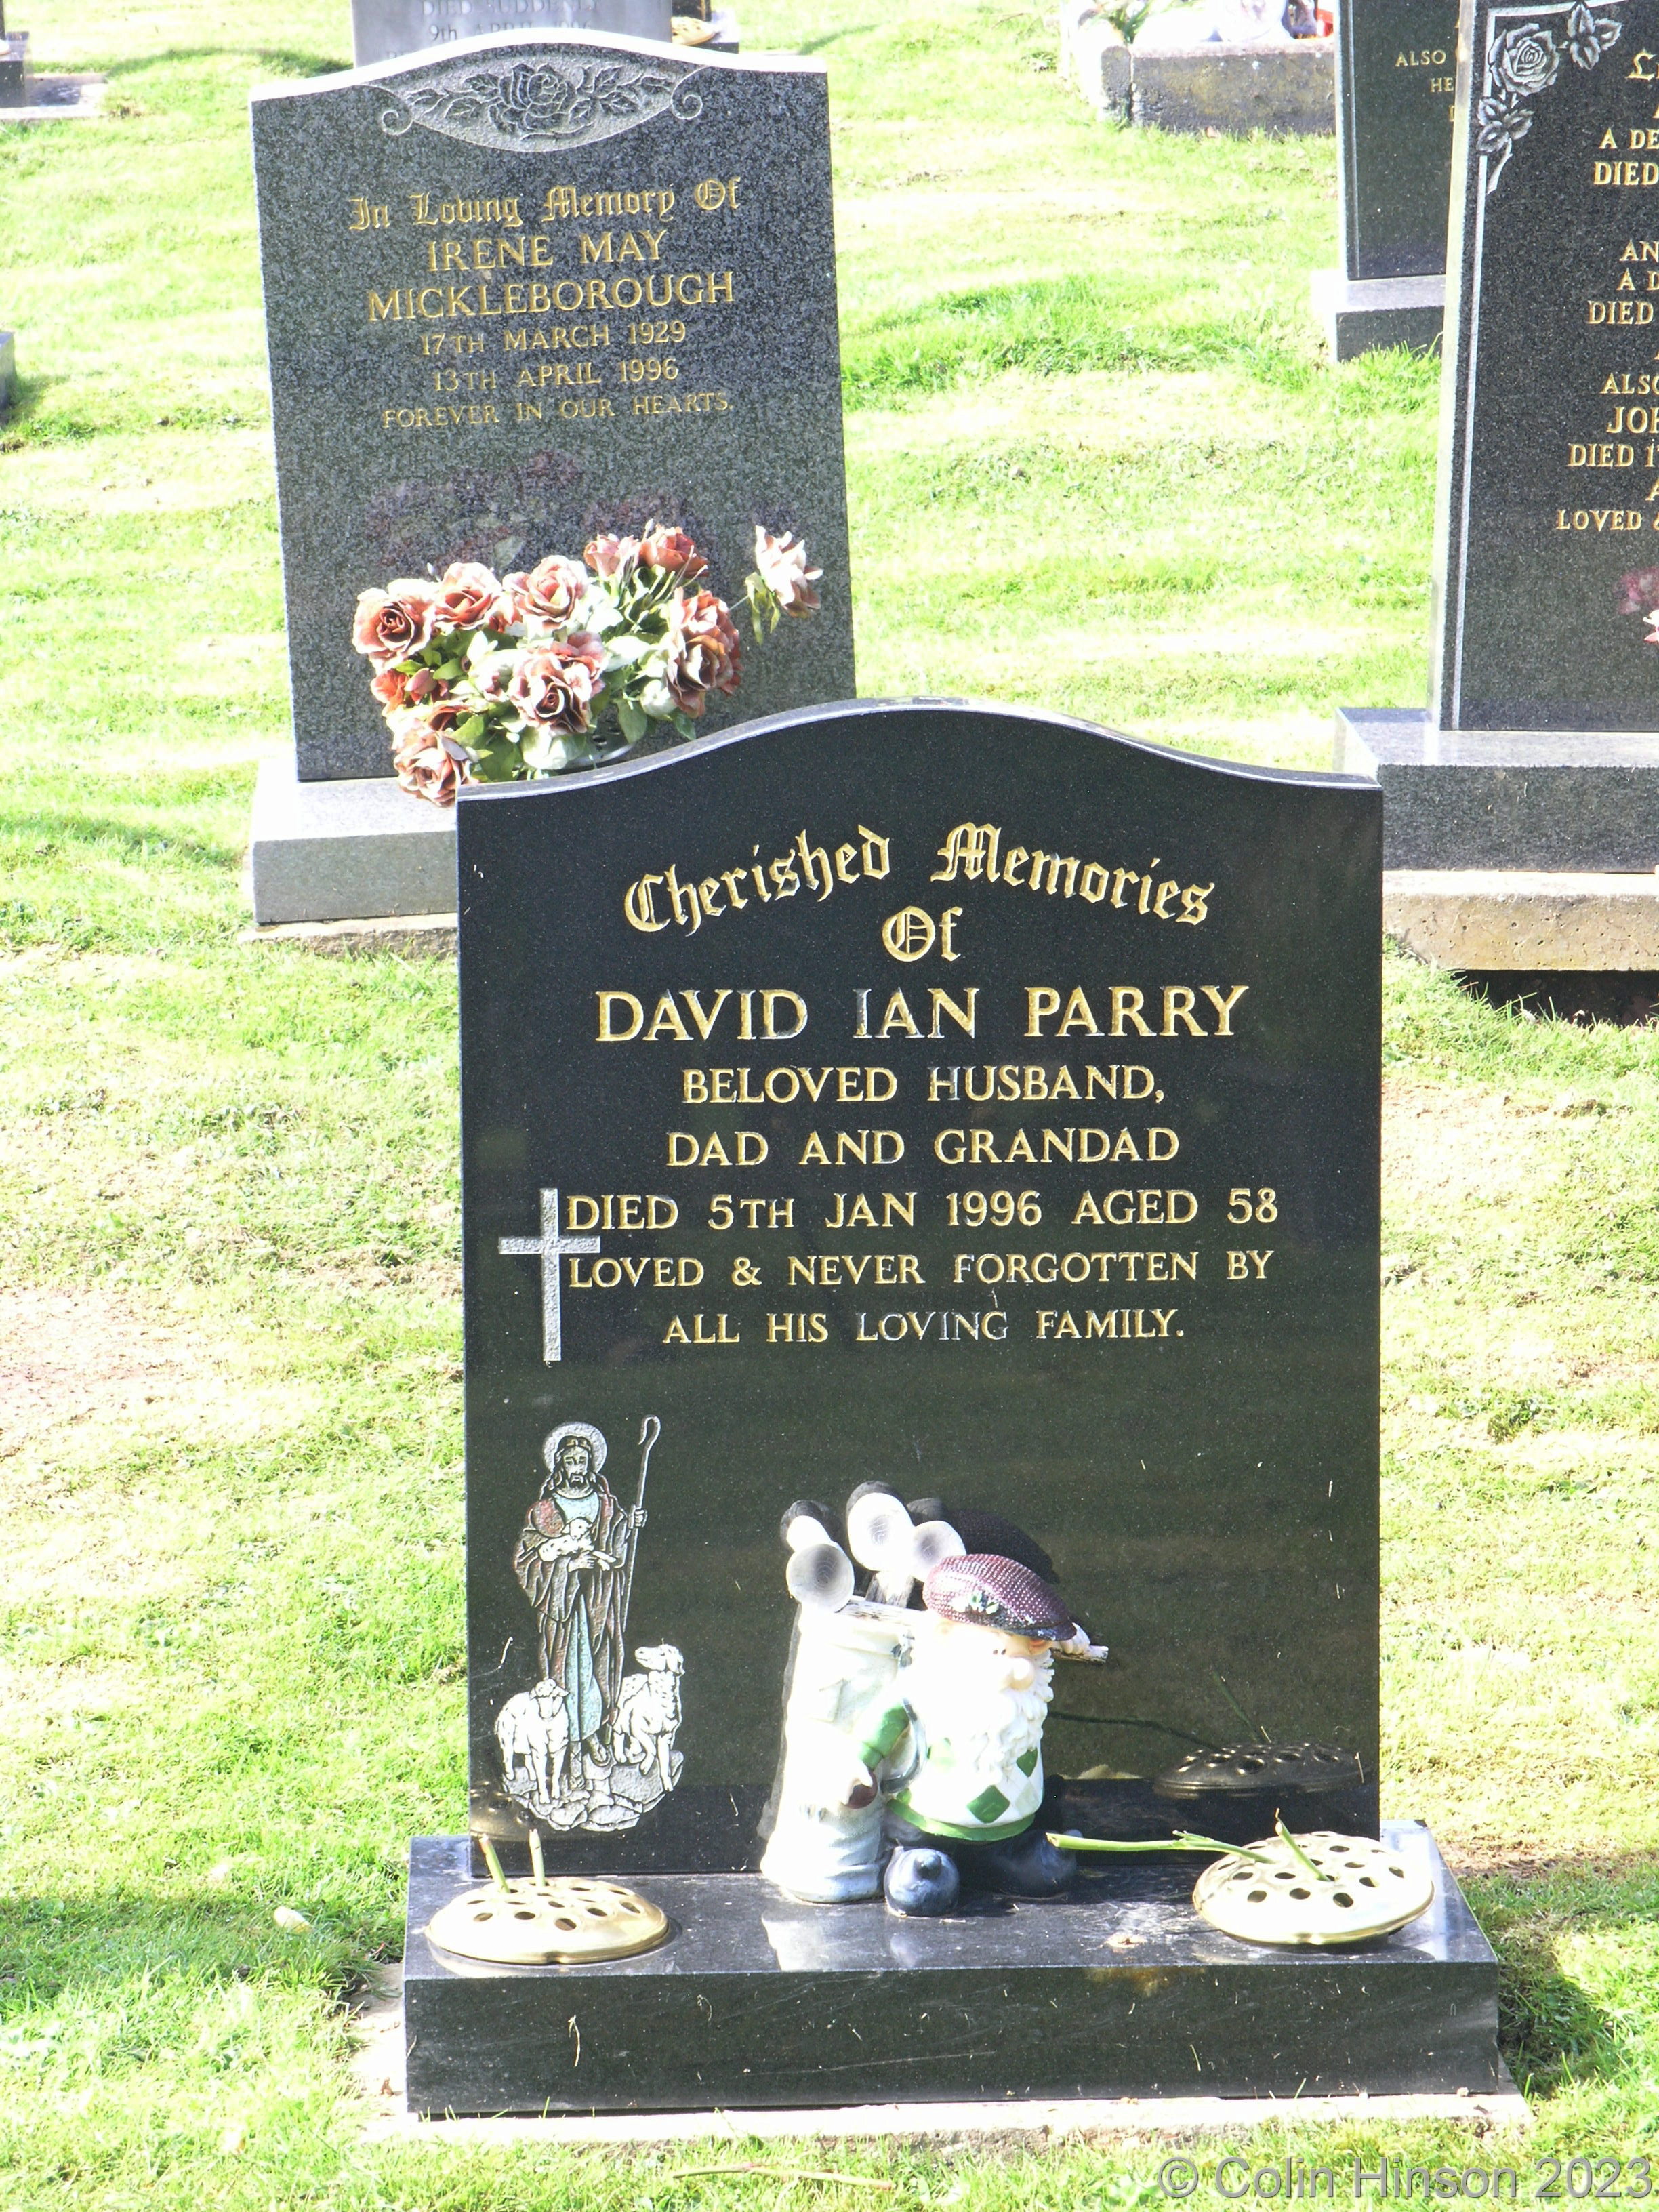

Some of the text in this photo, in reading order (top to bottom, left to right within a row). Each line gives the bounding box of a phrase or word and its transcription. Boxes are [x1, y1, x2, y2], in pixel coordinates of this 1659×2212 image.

[423, 0, 472, 15] DIED
[429, 23, 458, 41] 9th
[1395, 49, 1446, 67] ALSO
[1599, 127, 1618, 149] A
[1593, 161, 1659, 185] DIED
[348, 176, 742, 230] In Loving Memory Of
[427, 229, 668, 272] IRENE MAY
[1616, 268, 1636, 291] A
[367, 272, 735, 322] MICKLEBOROUGH
[1587, 301, 1654, 325] DIED
[421, 321, 687, 356] 17TH MARCH 1929
[434, 358, 679, 391] 13TH APRIL 1996
[382, 404, 499, 428] FOREVER
[516, 402, 543, 422] IN
[559, 398, 616, 419] OUR
[1567, 443, 1635, 467] DIED
[1556, 509, 1642, 531] LOVED
[623, 821, 1215, 937] Cherished Memories
[882, 905, 963, 962] Of
[596, 985, 1250, 1042] DAVID IAN PARRY
[682, 1065, 1164, 1104] BELOVED HUSBAND,
[666, 1127, 1180, 1166] DAD AND GRANDAD
[565, 1187, 1279, 1231] DIED 5TH JAN 1996 AGED 58
[569, 1250, 1275, 1288] LOVED & NEVER FORGOTTEN BY
[662, 1309, 1185, 1343] ALL HIS LOVING FAMILY.
